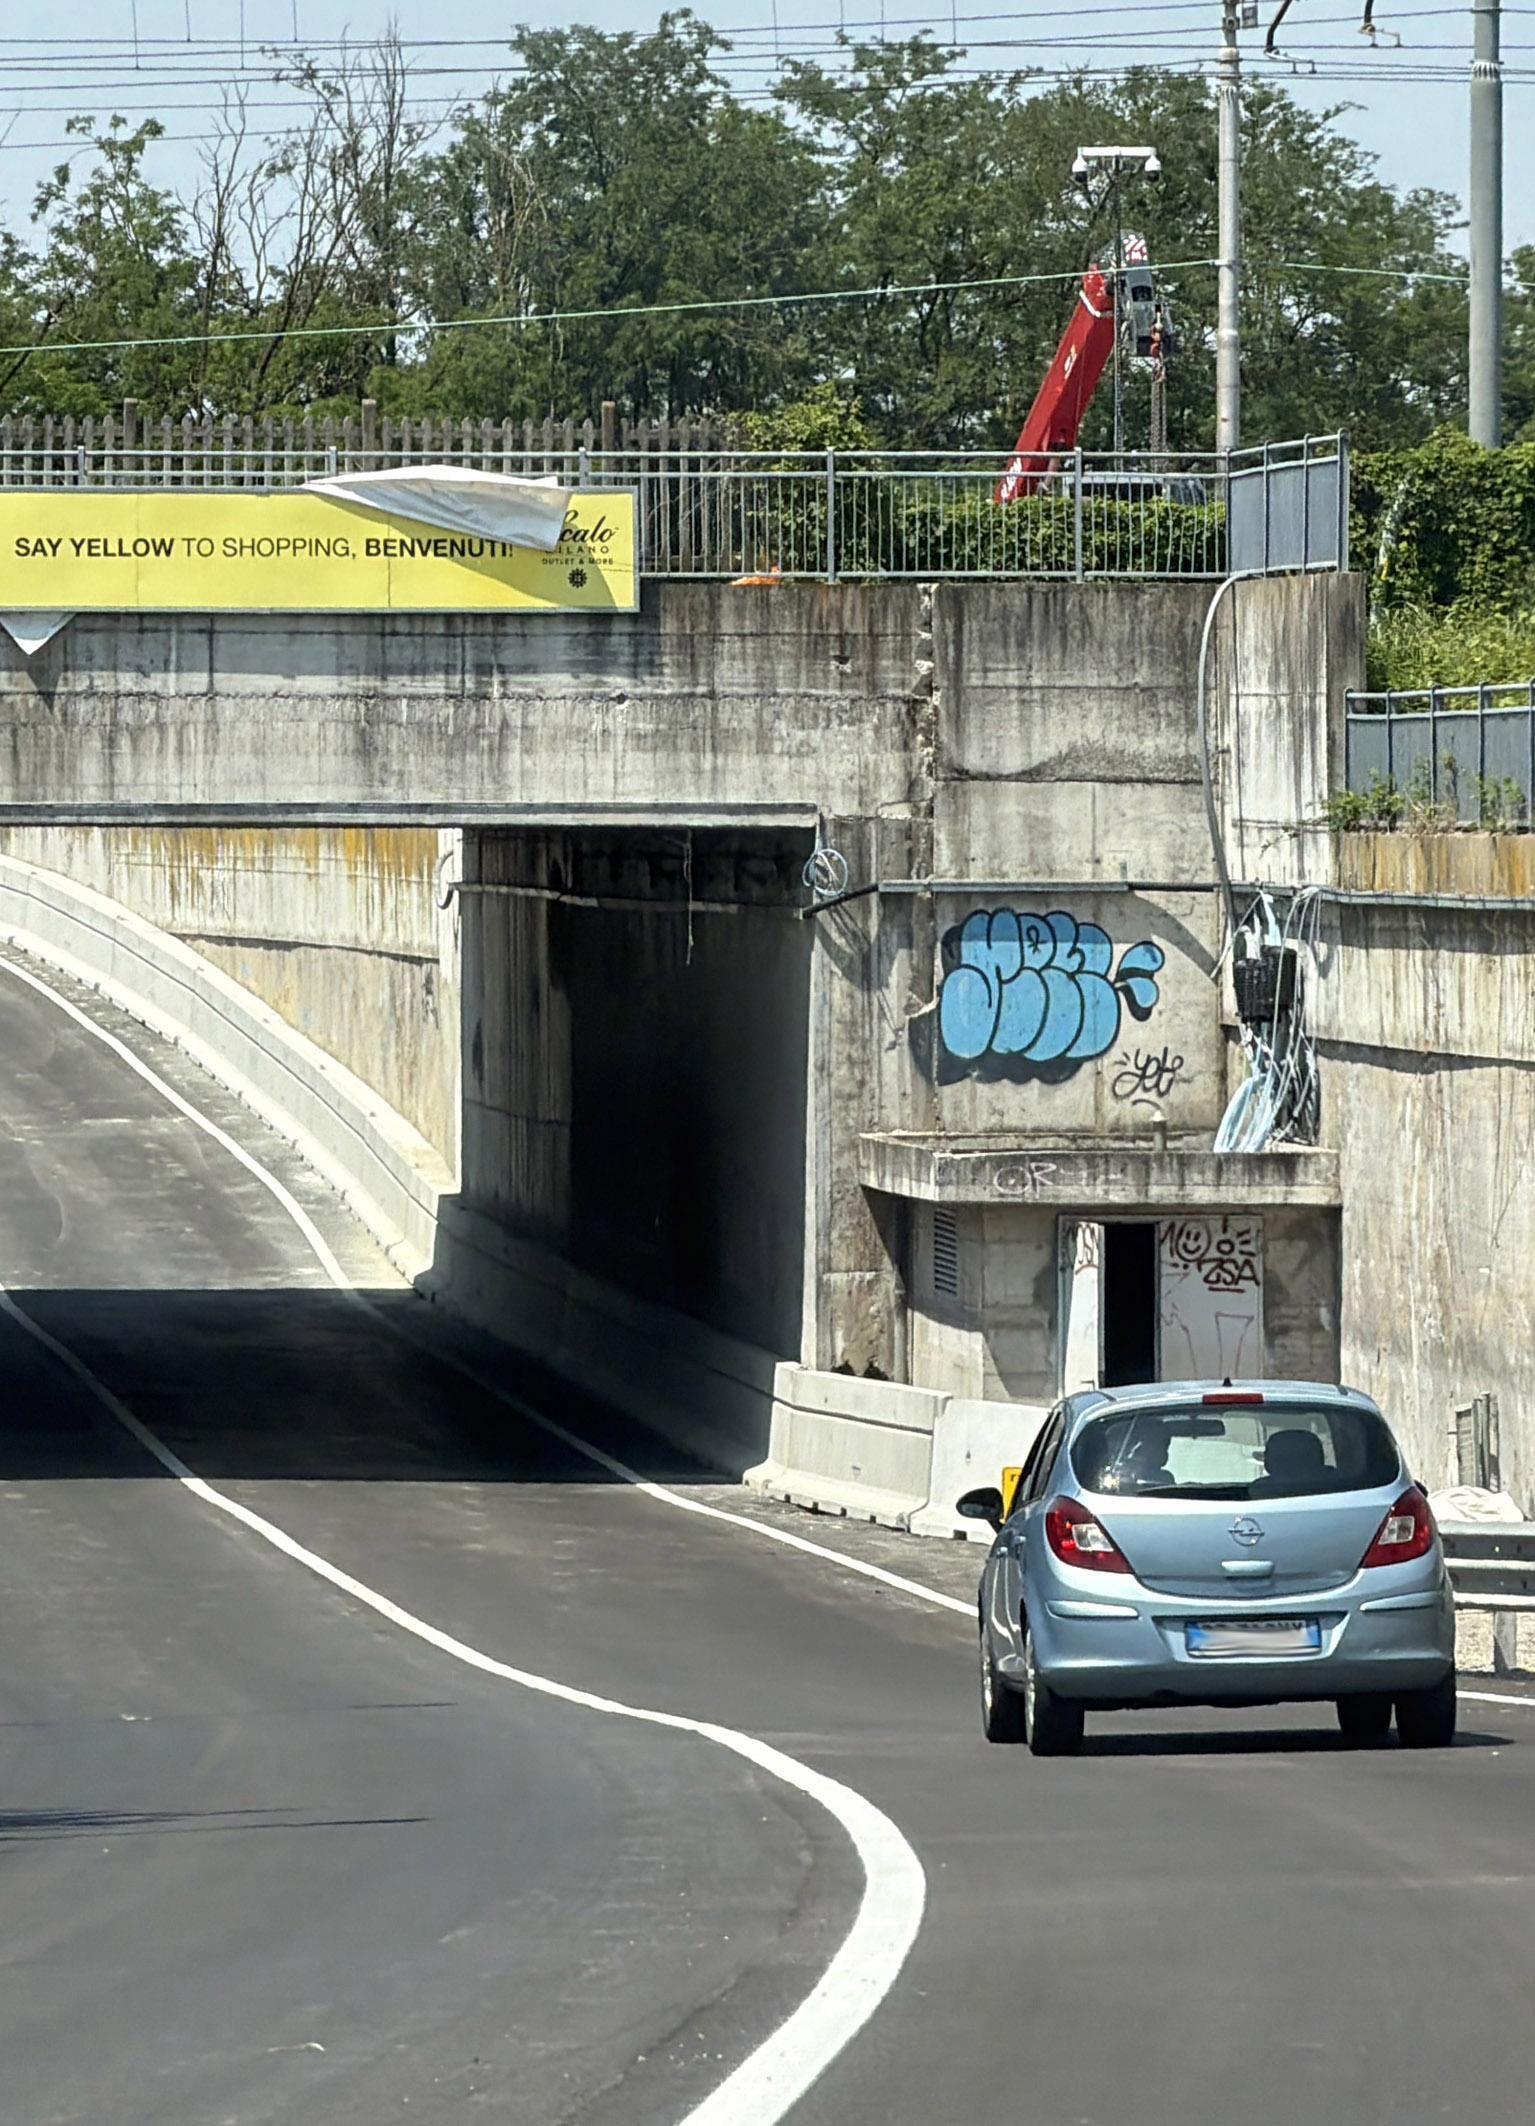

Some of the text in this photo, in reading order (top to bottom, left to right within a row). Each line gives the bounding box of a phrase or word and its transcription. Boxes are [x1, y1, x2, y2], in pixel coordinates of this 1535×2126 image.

[14, 538, 513, 560] SAY YELLOW TO SHOPPING, BENVENUTI!
[545, 545, 609, 554] ILANO
